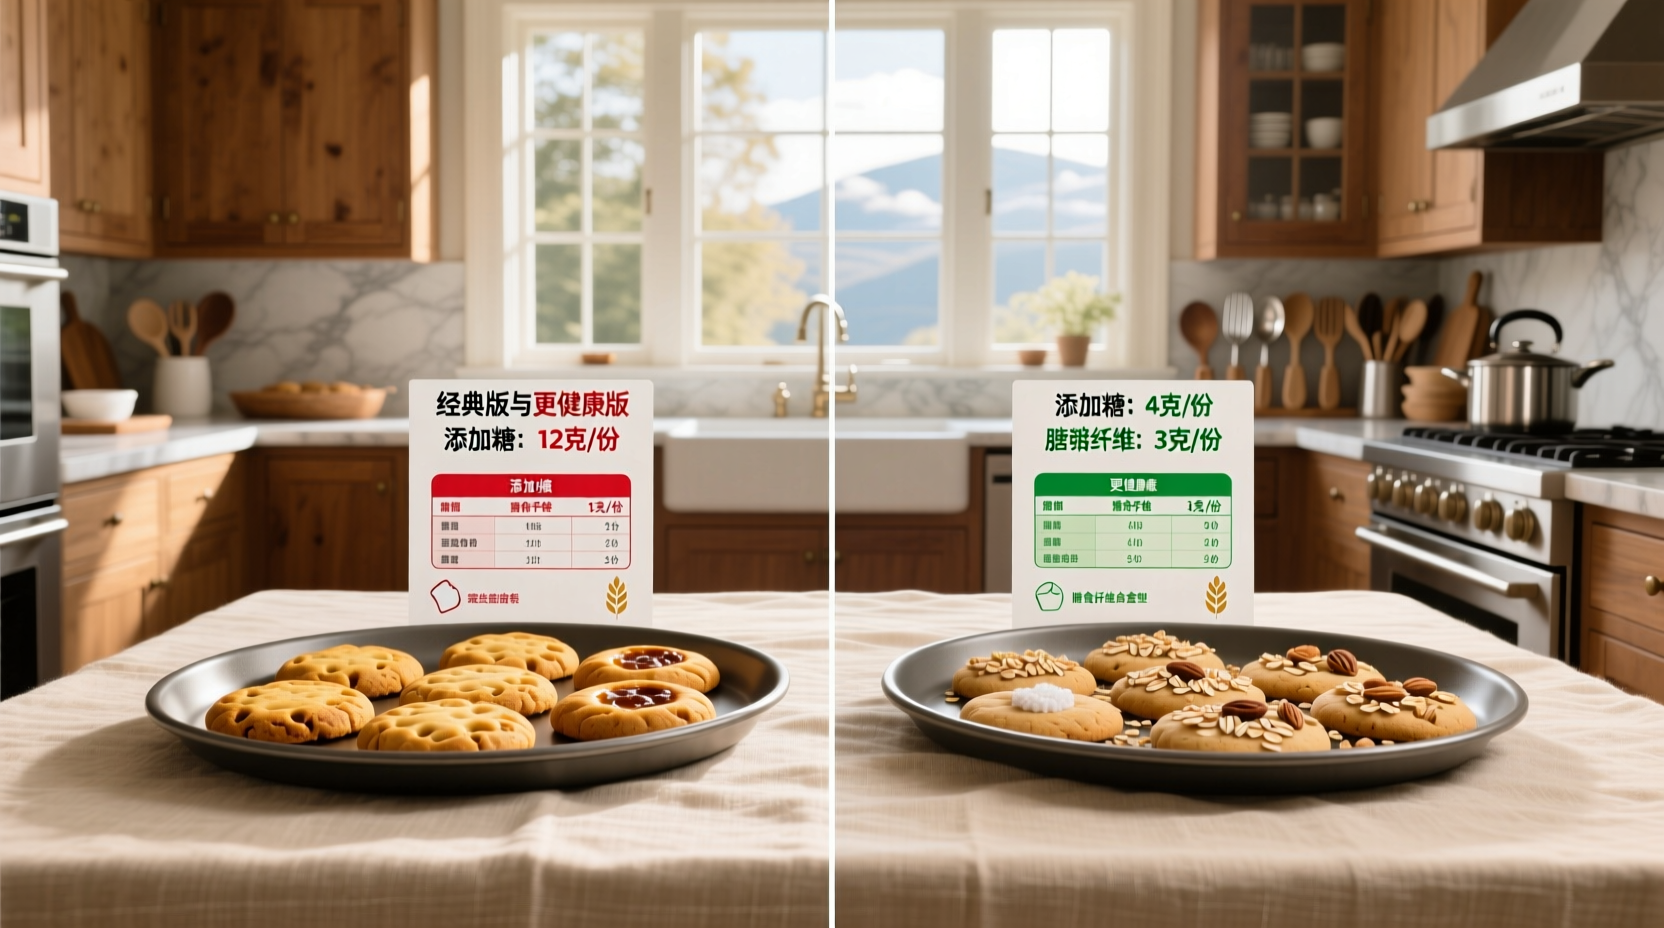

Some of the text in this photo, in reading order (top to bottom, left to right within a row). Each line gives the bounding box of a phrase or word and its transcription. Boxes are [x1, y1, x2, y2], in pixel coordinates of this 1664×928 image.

[436, 390, 630, 417] 经典版与更健康版
